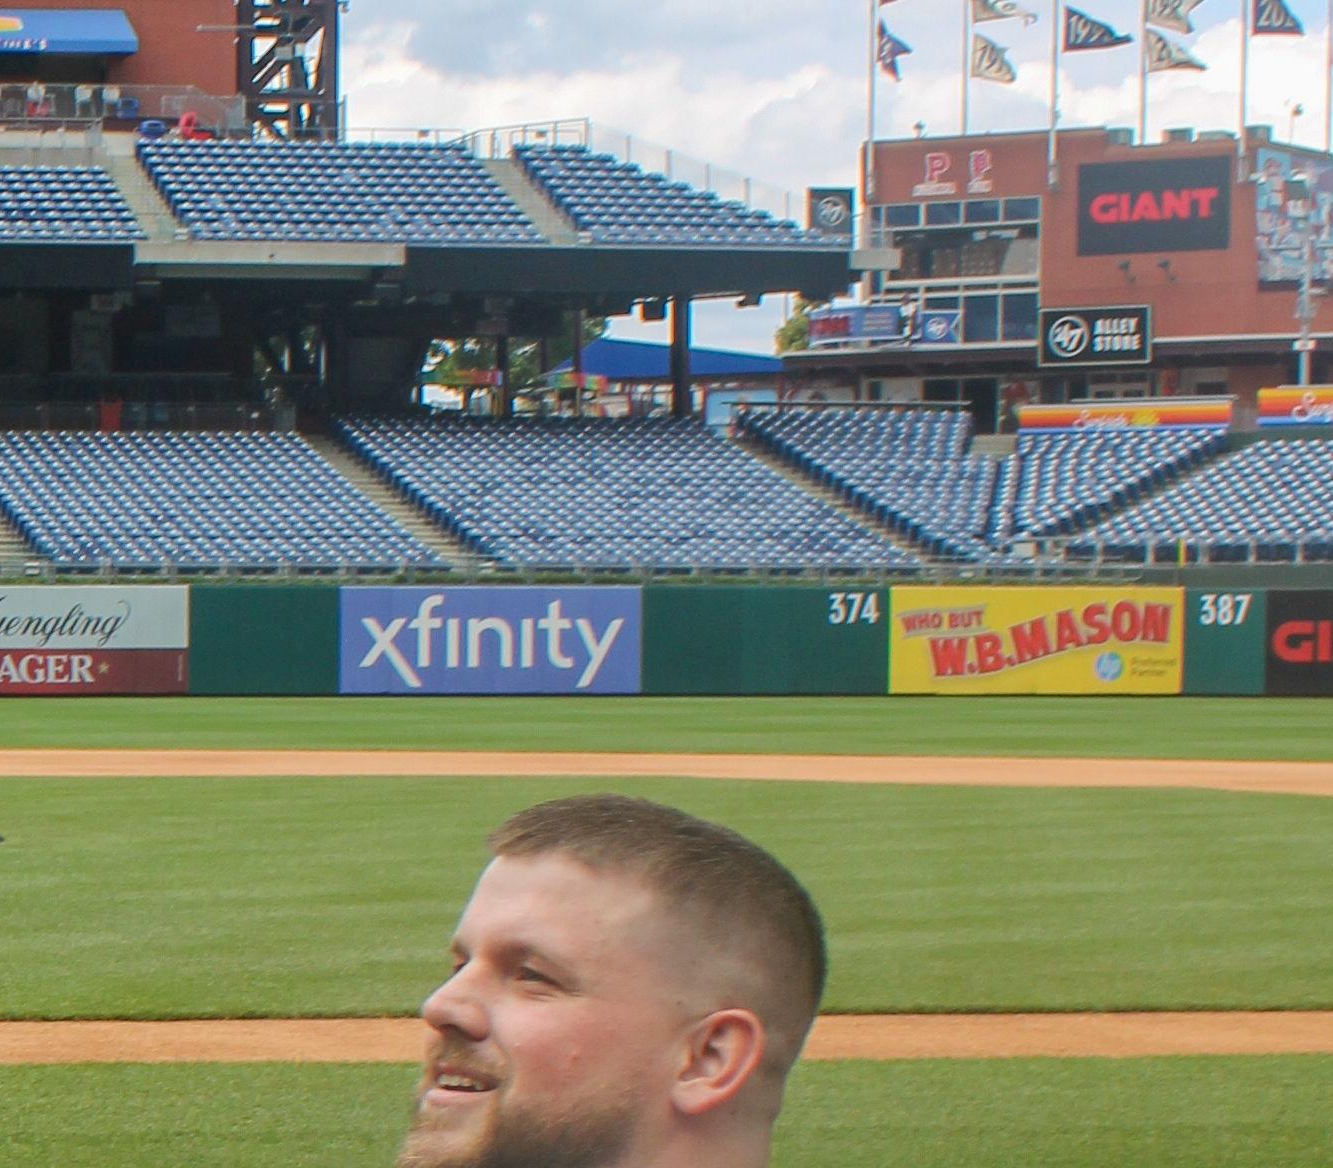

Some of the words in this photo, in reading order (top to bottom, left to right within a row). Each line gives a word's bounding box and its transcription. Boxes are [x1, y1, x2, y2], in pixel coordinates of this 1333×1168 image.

[1089, 187, 1219, 224] GIANT
[1093, 317, 1139, 335] ALLEY
[1093, 334, 1142, 352] STORE
[828, 592, 880, 624] 374
[899, 613, 943, 634] WHO
[948, 610, 984, 630] BUT
[1199, 594, 1253, 625] 387
[358, 594, 625, 688] xfinity
